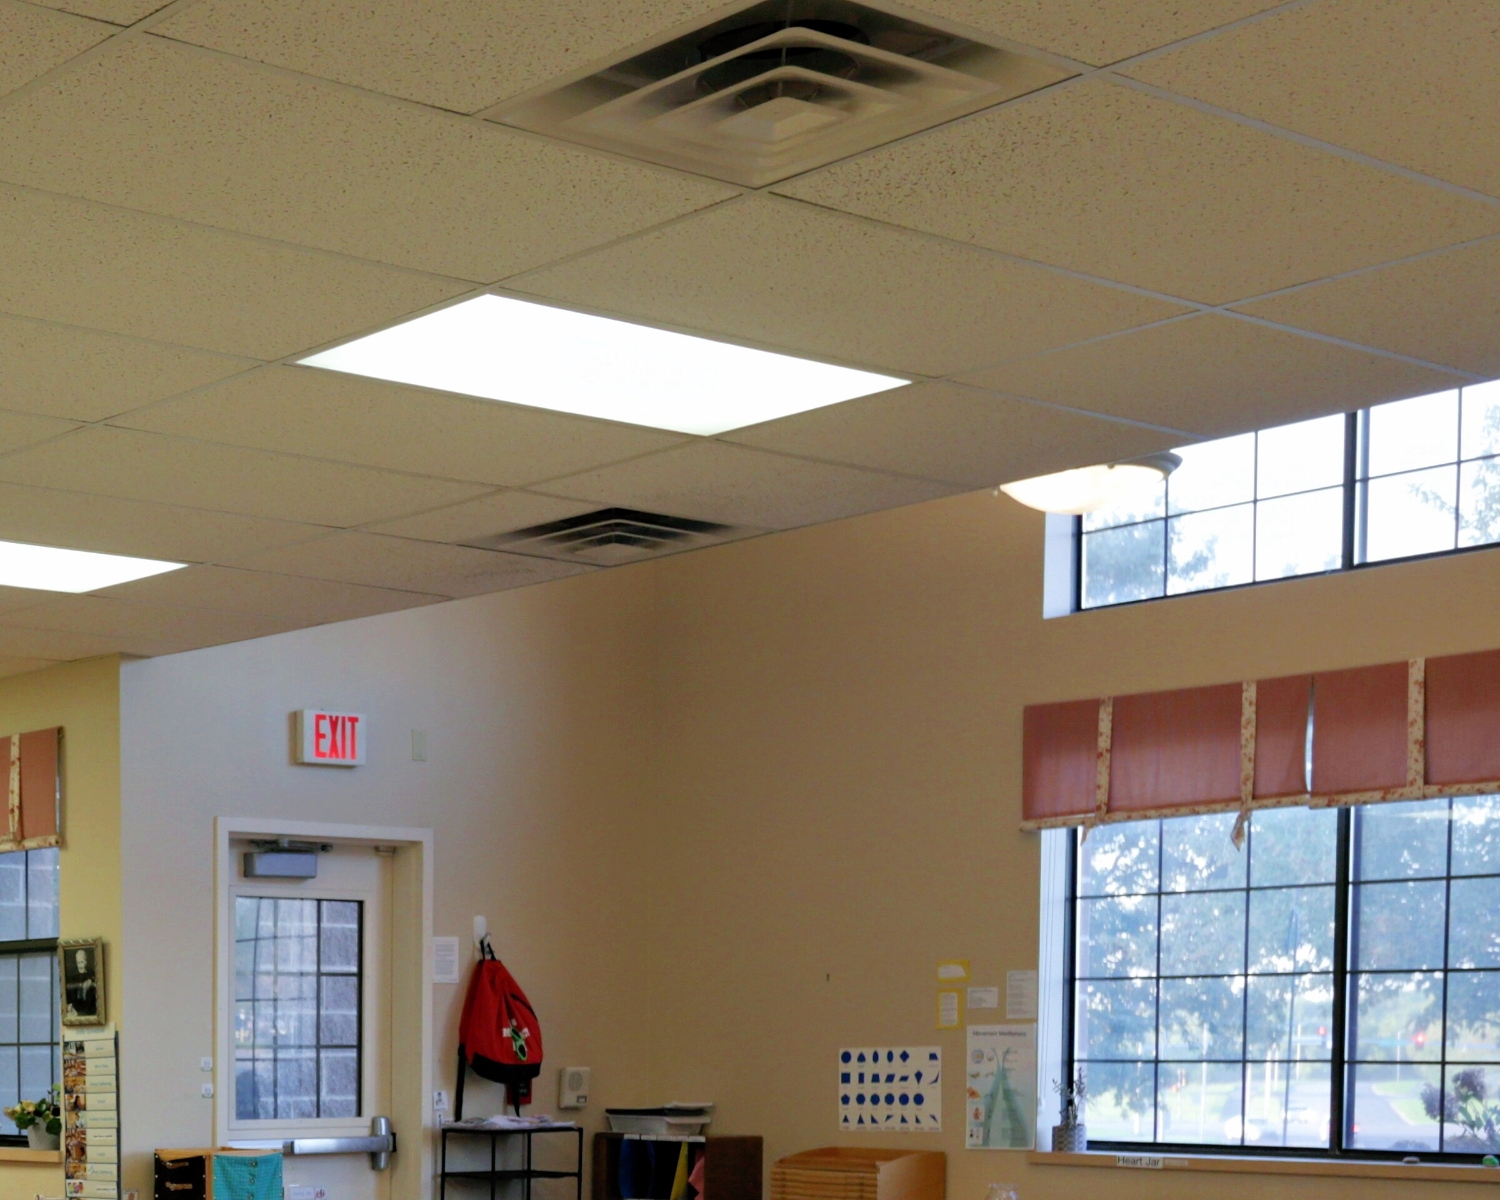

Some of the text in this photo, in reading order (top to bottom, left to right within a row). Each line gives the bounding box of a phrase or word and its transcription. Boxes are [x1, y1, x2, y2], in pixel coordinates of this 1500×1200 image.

[314, 713, 360, 761] EXIT
[1117, 1156, 1143, 1166] Heart
[1145, 1157, 1161, 1167] Jar
